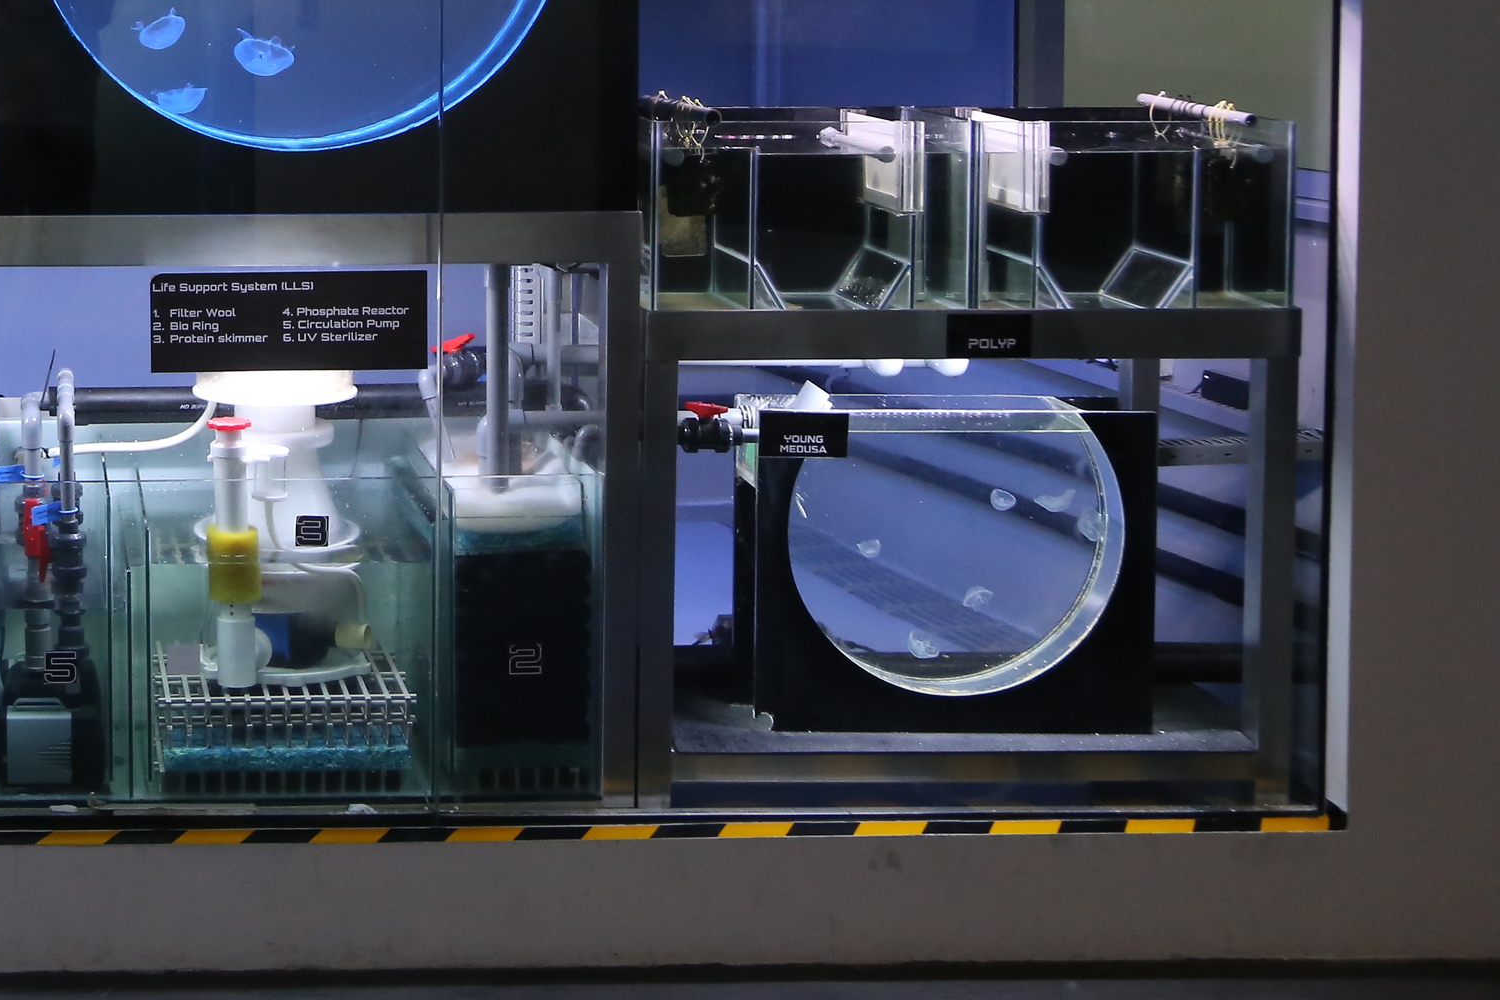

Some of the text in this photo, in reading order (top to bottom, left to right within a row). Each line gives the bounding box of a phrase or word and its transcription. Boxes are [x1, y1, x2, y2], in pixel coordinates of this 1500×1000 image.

[153, 283, 175, 292] Life
[180, 283, 227, 294] Support
[232, 282, 277, 293] System
[170, 309, 202, 317] Filter
[206, 308, 236, 317] Wool
[283, 306, 409, 318] 4. Phosphate Reactor
[153, 321, 219, 332] 2. Bio Ring
[283, 319, 399, 330] 5. Circulation Pump
[153, 334, 268, 343] 3. Protein skimmer
[283, 332, 378, 342] 6. UV Sterilizer
[969, 339, 1016, 349] POLYP
[783, 435, 825, 444] YOUNG
[780, 445, 827, 453] MEDUSA
[296, 516, 327, 546] 3
[508, 643, 543, 676] 2
[45, 651, 77, 684] 5
